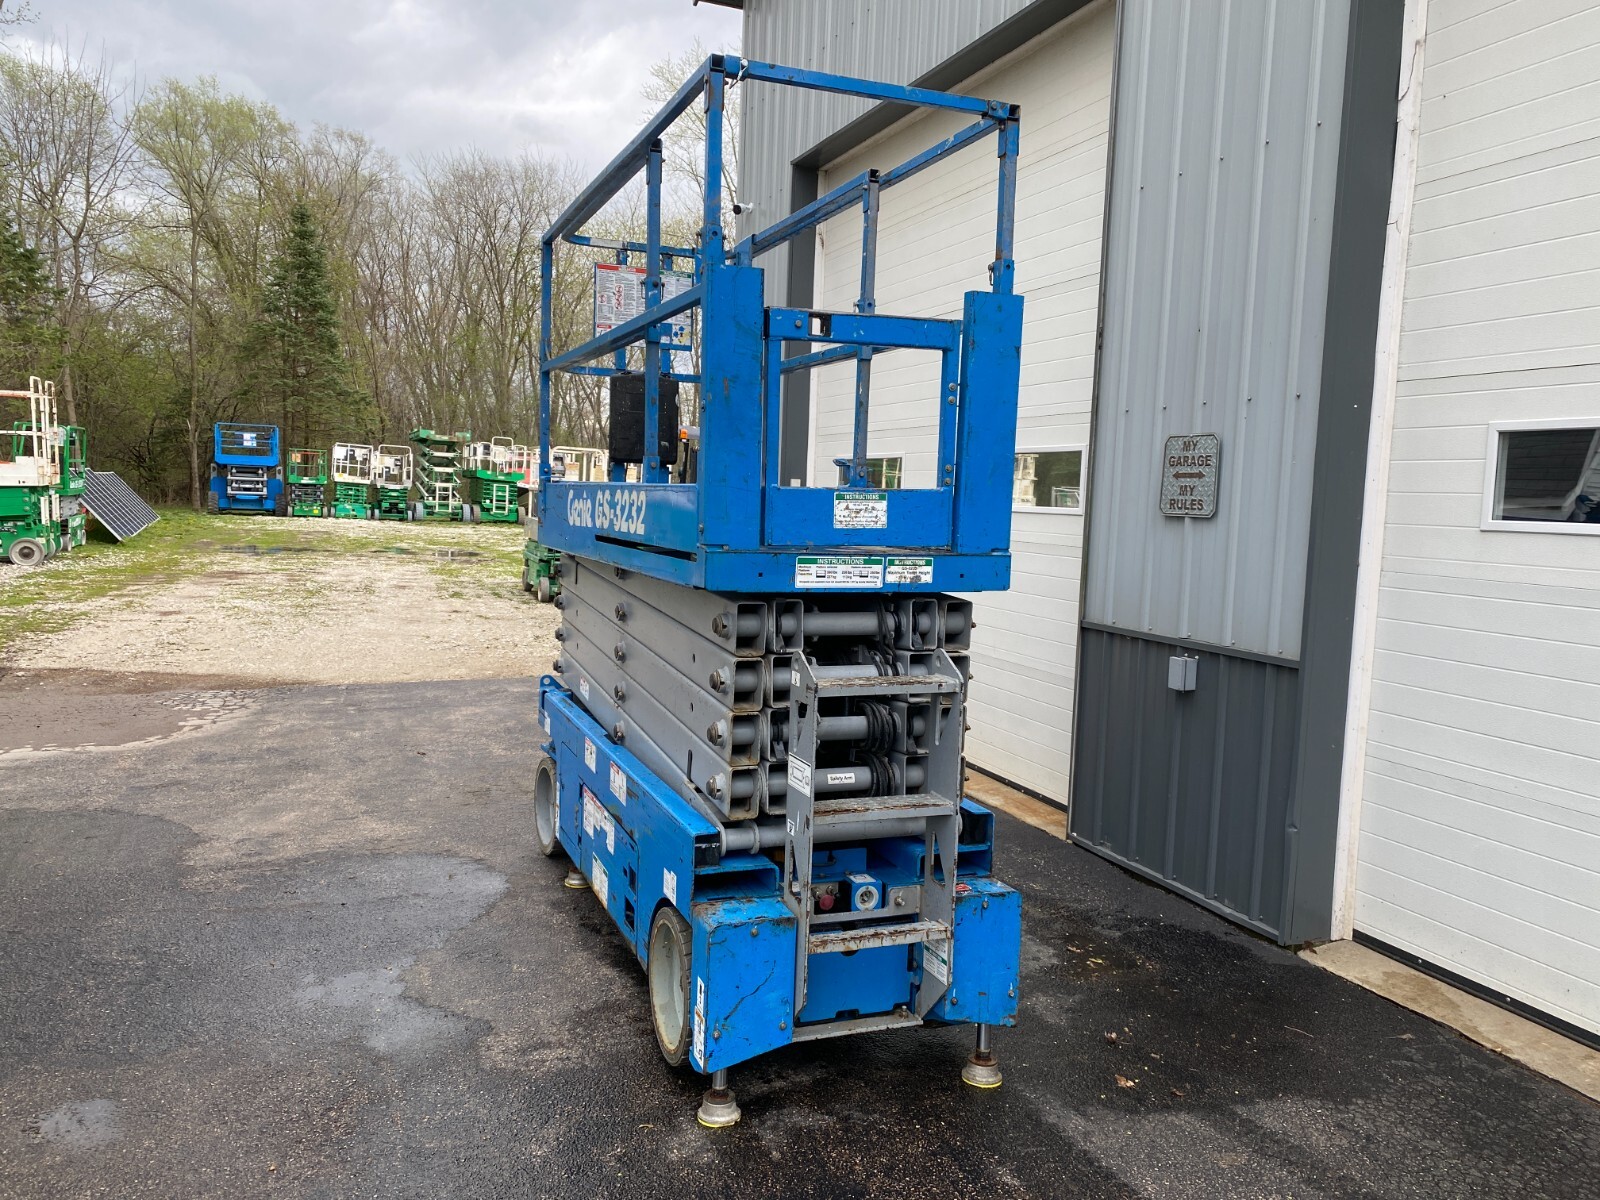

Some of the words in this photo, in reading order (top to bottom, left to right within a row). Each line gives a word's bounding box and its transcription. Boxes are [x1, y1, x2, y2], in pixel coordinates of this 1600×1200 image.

[1183, 441, 1198, 452] MY
[1169, 455, 1212, 467] GARAGE
[1179, 485, 1195, 496] MY
[1169, 499, 1204, 511] RULES
[567, 489, 593, 528] Genie
[595, 489, 646, 535] GS-3232
